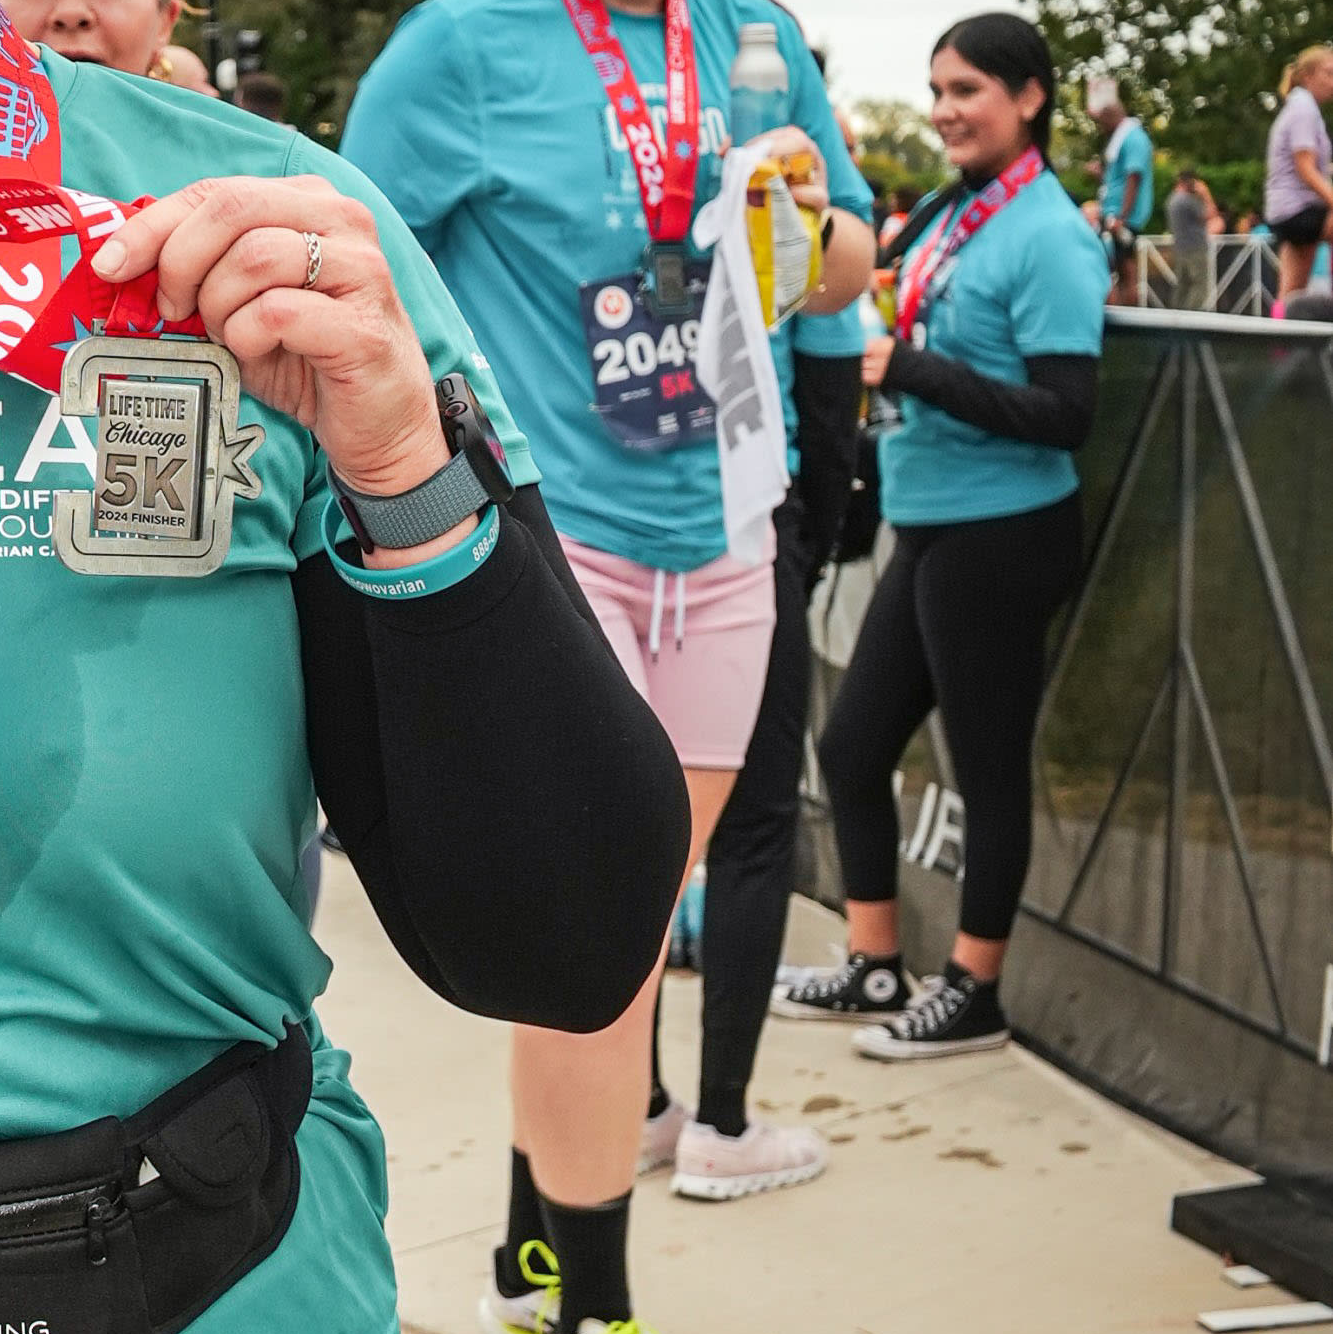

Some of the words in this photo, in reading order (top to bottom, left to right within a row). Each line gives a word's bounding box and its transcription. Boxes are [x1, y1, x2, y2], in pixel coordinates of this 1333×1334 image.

[660, 370, 695, 401] 5K
[105, 419, 187, 456] Chicago
[100, 453, 188, 511] 5K
[98, 510, 127, 522] 2024
[131, 513, 186, 527] FINISHER
